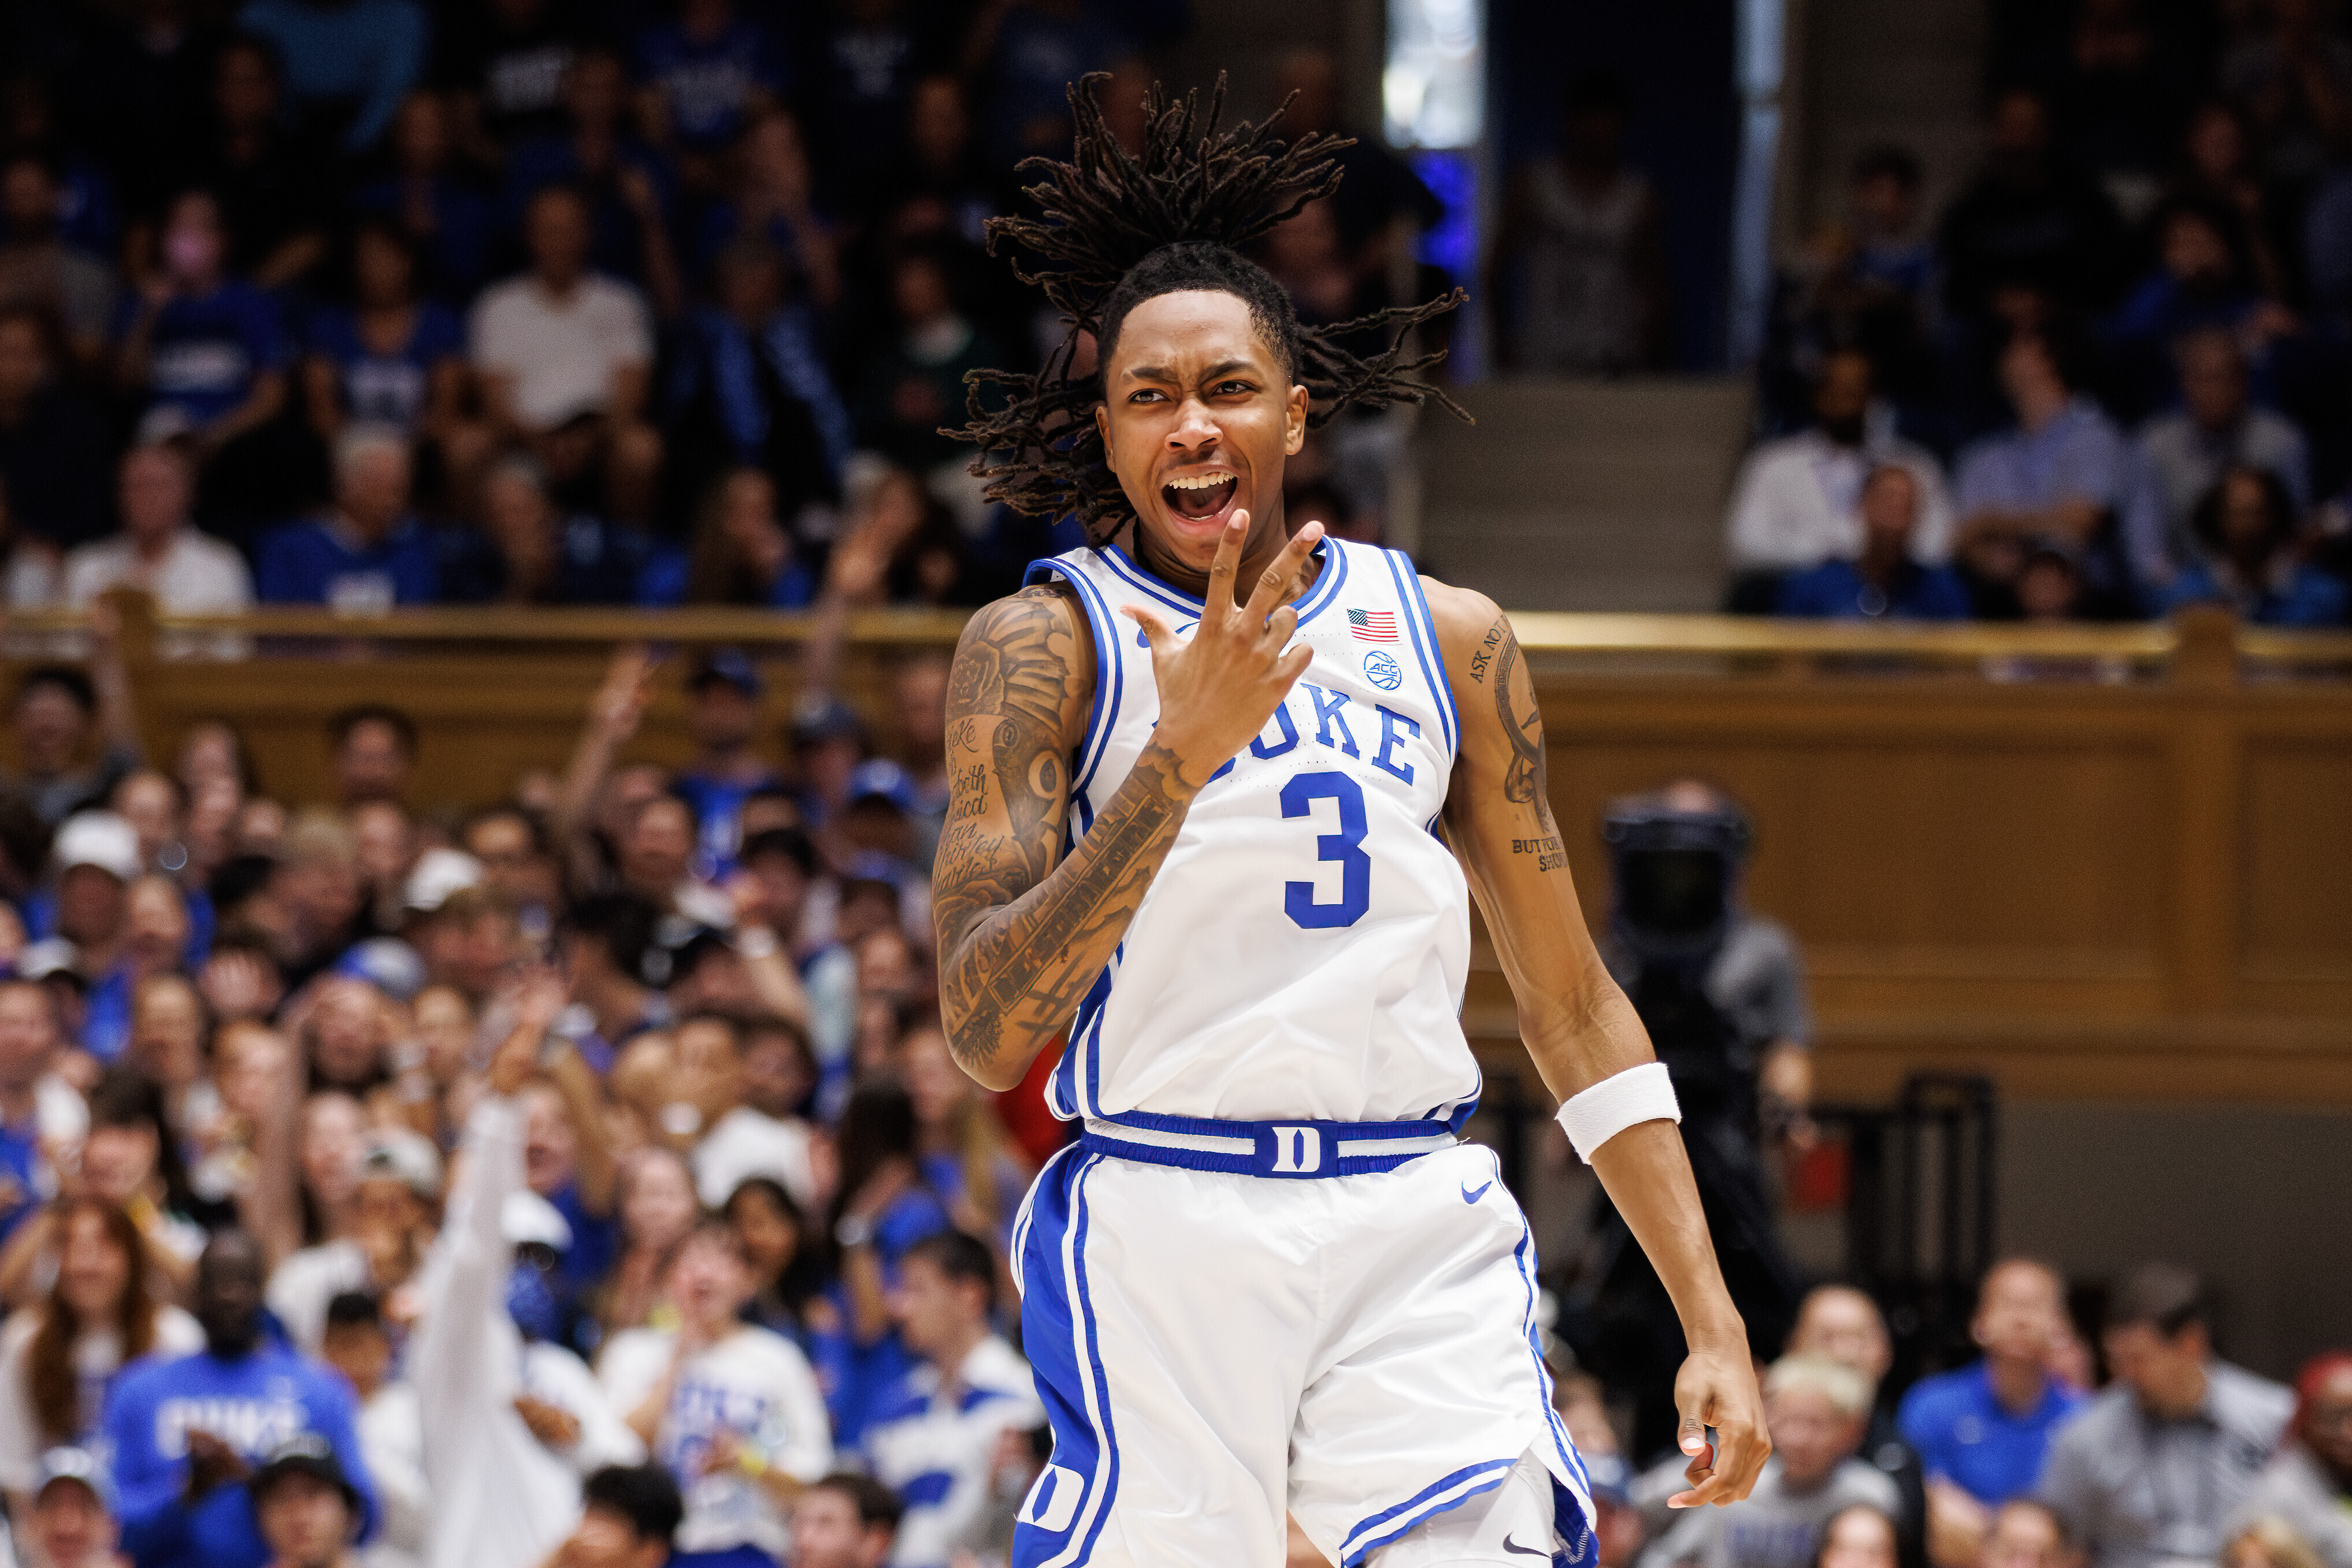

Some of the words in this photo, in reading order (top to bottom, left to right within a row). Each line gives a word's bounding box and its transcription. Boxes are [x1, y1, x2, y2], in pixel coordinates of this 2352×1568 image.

[1470, 650, 1492, 683] ASK
[1483, 620, 1507, 650] NOT
[1279, 771, 1371, 929] 3
[1512, 839, 1541, 853] BUT
[1271, 1127, 1320, 1172] D
[1018, 1463, 1084, 1532] D
